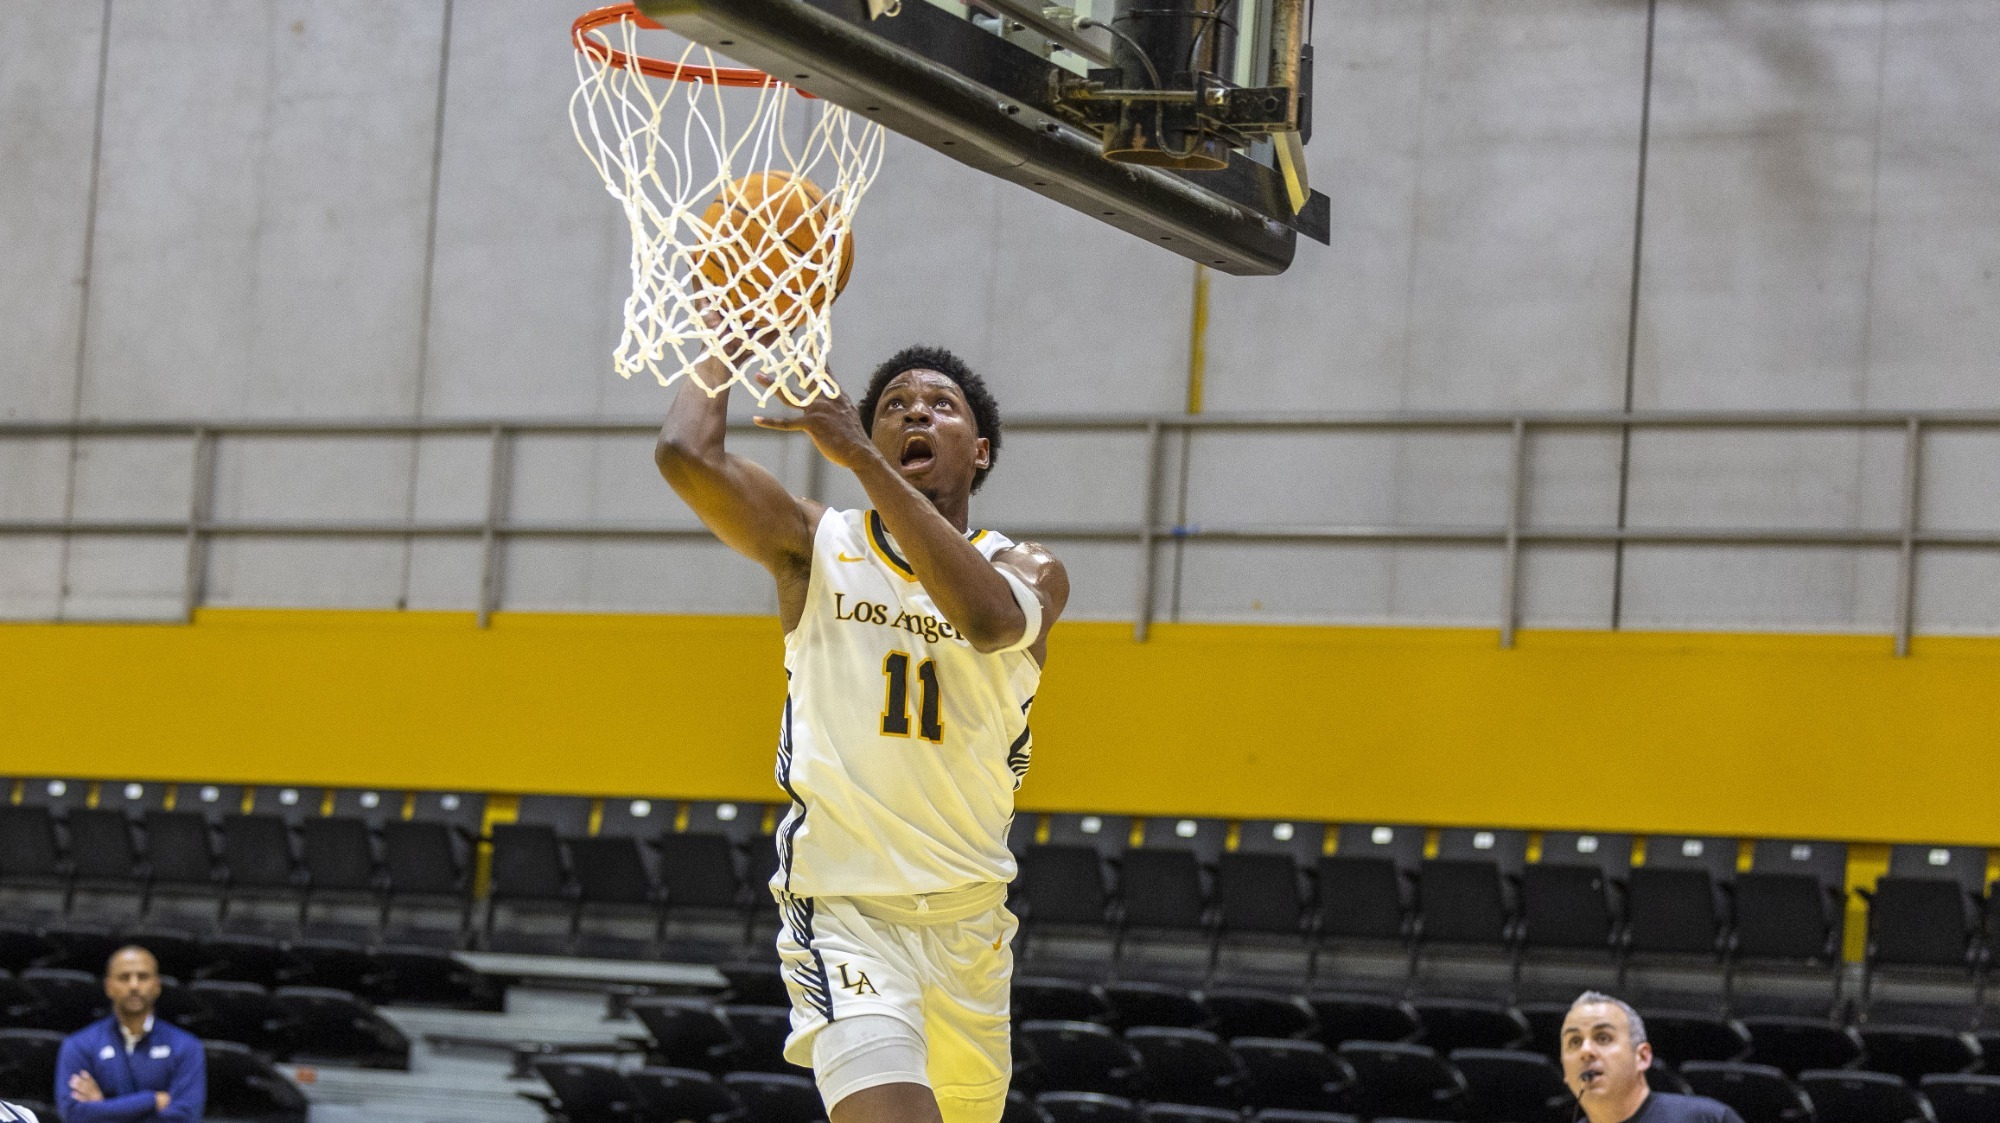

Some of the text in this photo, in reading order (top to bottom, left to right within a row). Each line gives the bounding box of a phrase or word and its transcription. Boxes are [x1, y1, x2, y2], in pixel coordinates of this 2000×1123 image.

[834, 592, 888, 625] Los
[879, 649, 945, 745] 11
[836, 962, 881, 997] LA
